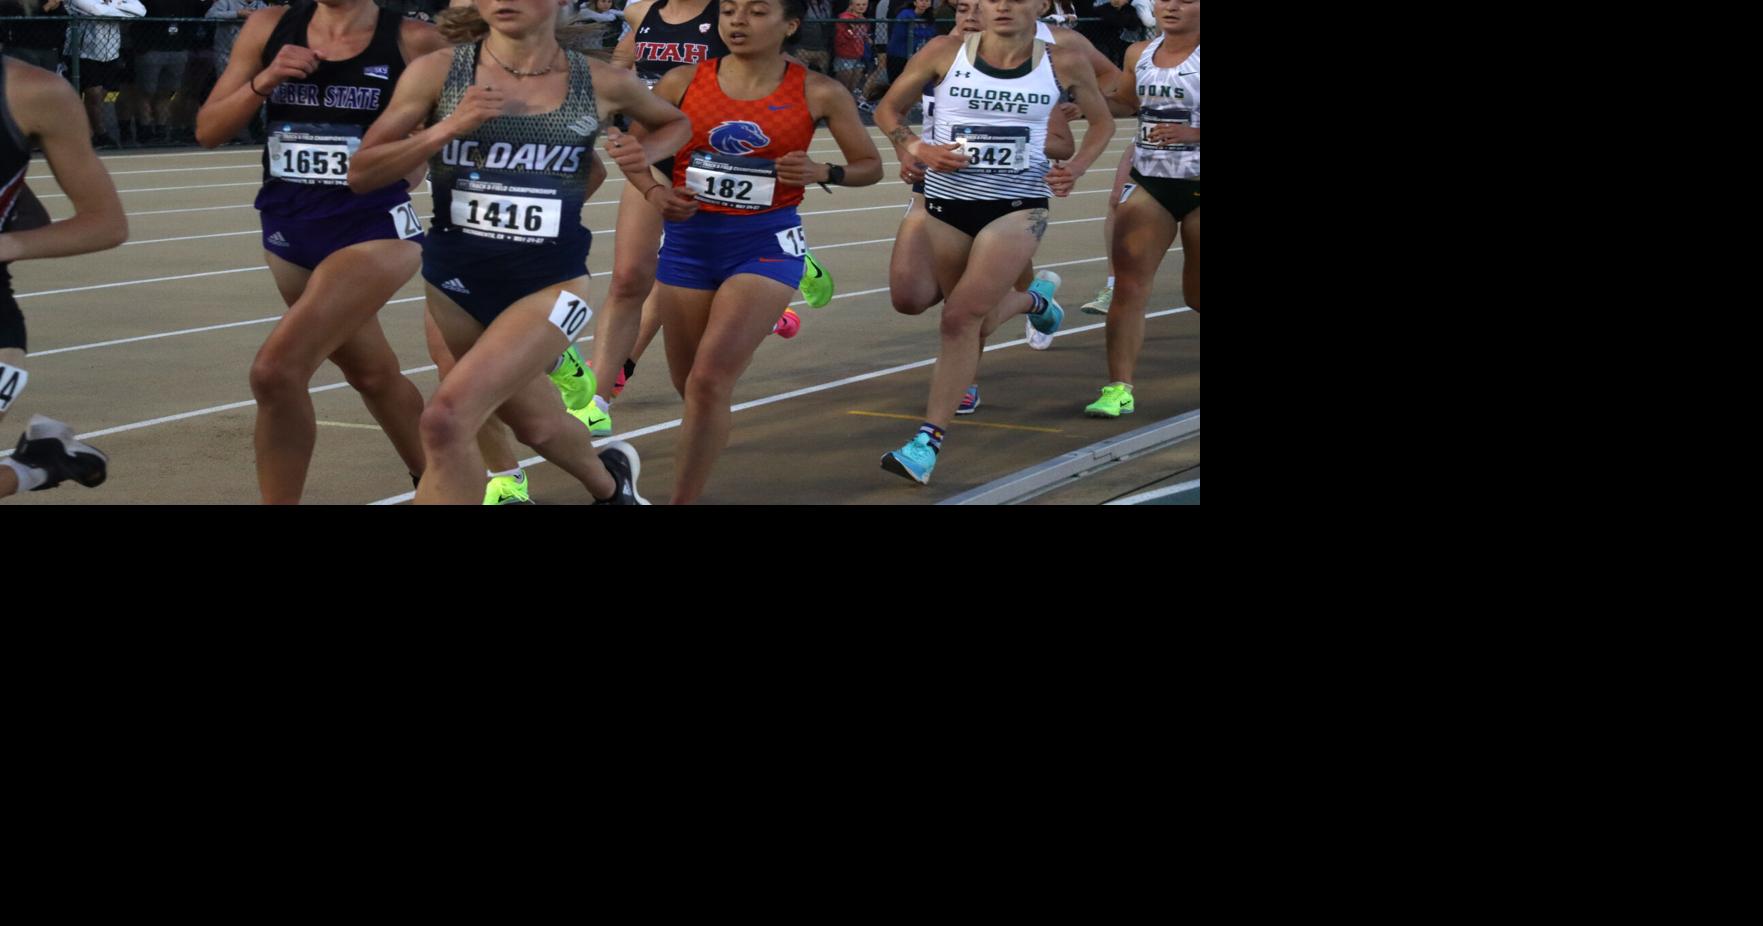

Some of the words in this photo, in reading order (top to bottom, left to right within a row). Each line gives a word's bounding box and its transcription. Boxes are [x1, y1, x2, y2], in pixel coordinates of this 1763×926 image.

[634, 41, 708, 64] UTAH
[323, 85, 380, 109] STATE
[949, 86, 1050, 105] COLORADO
[1138, 85, 1184, 98] DONS
[968, 99, 1029, 114] STATE
[283, 149, 348, 176] 1653
[442, 139, 479, 167] UC
[485, 141, 585, 173] DAVIS
[968, 147, 1012, 166] 342
[704, 176, 753, 201] 182
[397, 203, 422, 236] 20
[466, 199, 543, 232] 1416
[560, 299, 587, 336] 10
